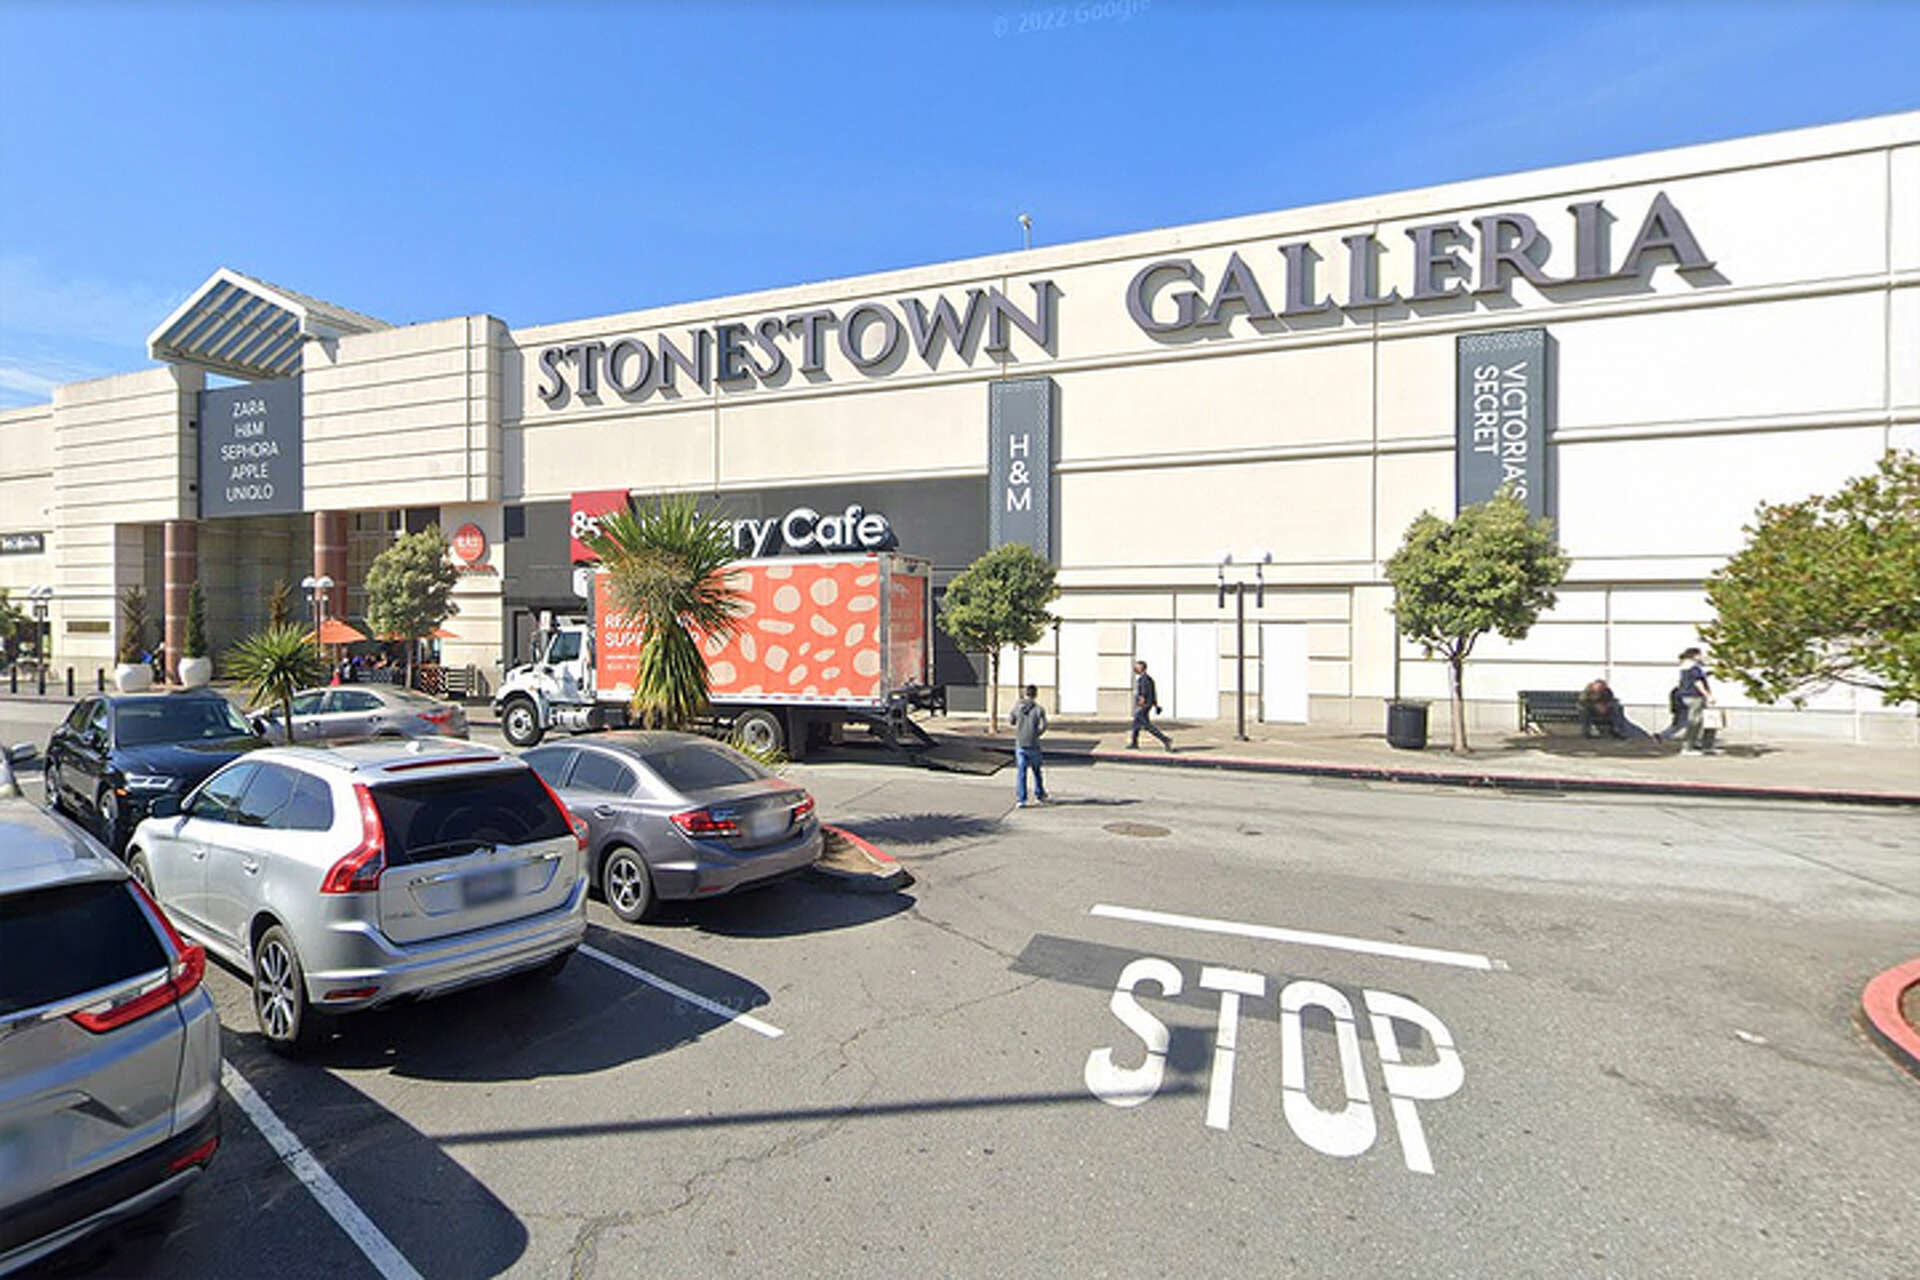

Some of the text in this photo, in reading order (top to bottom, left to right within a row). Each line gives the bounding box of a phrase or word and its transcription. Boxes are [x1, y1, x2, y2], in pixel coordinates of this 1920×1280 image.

[538, 190, 1718, 401] STONESTOWN GALLERIA
[232, 399, 268, 418] ZARA
[1473, 364, 1499, 456] SECRET
[1502, 361, 1528, 500] VICTORIA'S
[221, 441, 279, 461] SEPHORA
[231, 462, 269, 481] APPLE
[1006, 433, 1032, 512] H&M
[781, 504, 887, 548] Cafe
[1084, 957, 1465, 1175] STOP
